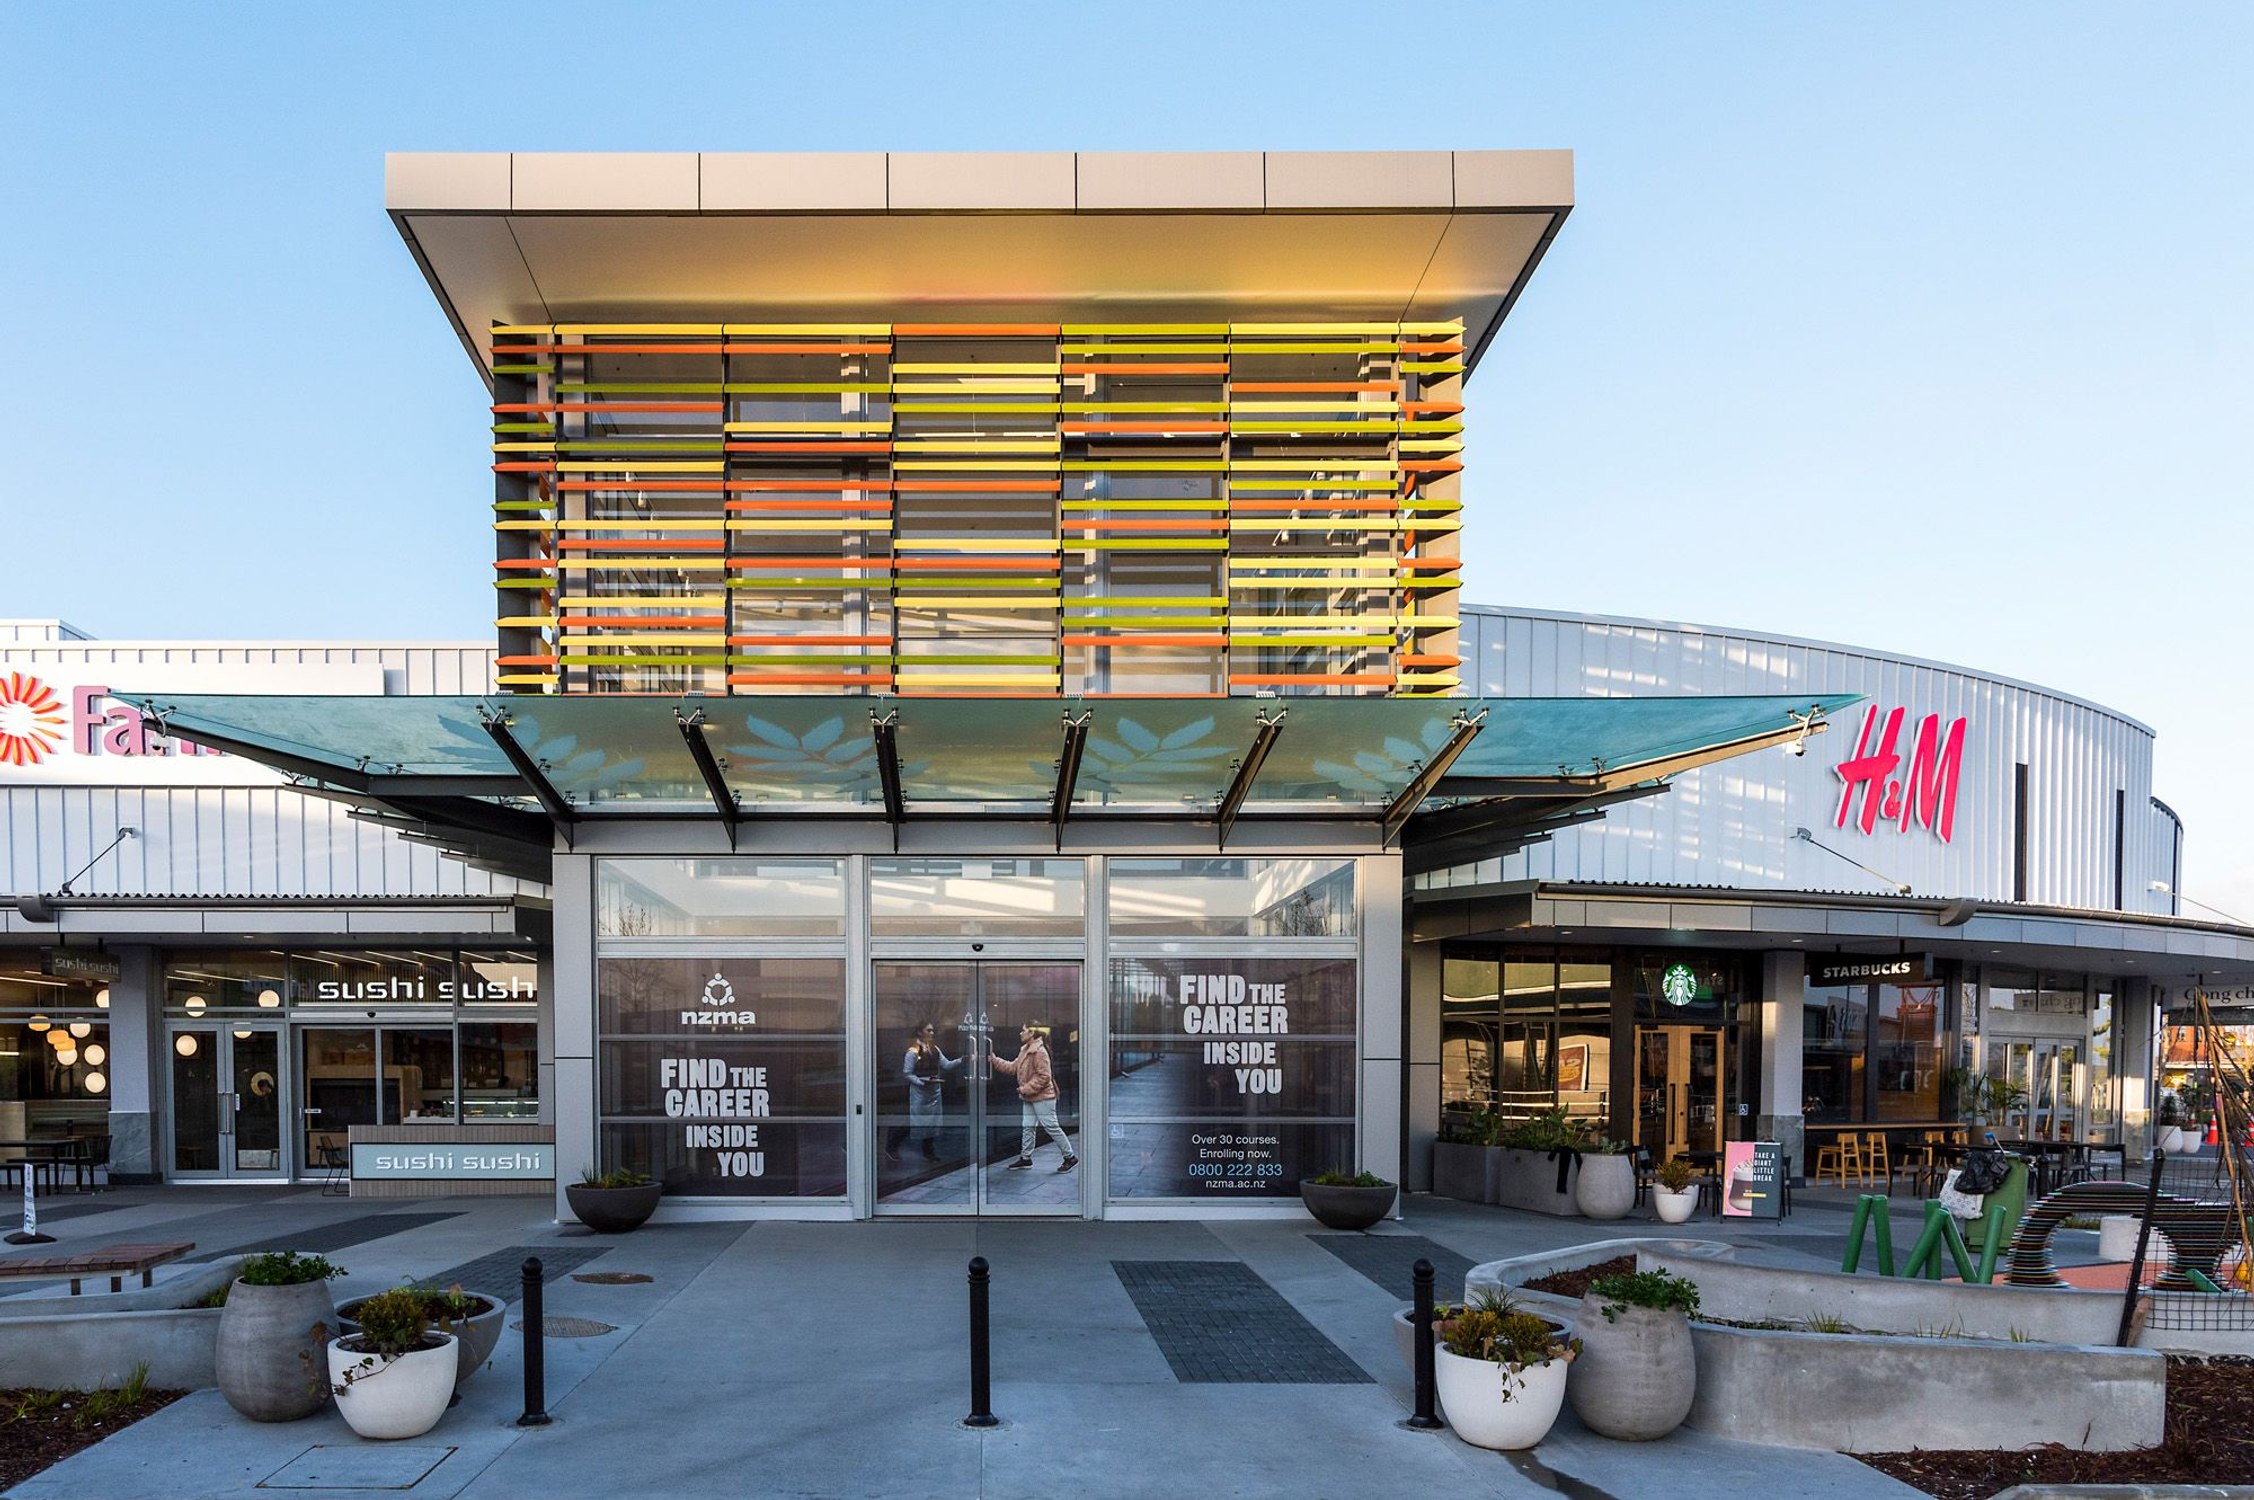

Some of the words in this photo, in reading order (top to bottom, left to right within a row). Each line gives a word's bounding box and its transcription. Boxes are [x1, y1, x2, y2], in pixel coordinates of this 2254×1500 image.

[1833, 704, 1967, 844] H&M
[55, 958, 87, 971] sushi
[89, 962, 119, 975] sushi
[1823, 962, 1911, 978] STARBUCKS
[318, 976, 424, 999] sushi
[438, 976, 534, 999] sush
[1180, 975, 1246, 1005] FIND
[1248, 984, 1286, 1005] THE
[681, 1010, 756, 1025] nzma
[1183, 1005, 1288, 1034] CAREER
[1203, 1042, 1276, 1065] INSIDE
[660, 1058, 727, 1088] FIND
[730, 1067, 767, 1088] THE
[1235, 1068, 1282, 1094] YOU
[665, 1089, 770, 1118] CAREER
[686, 1125, 758, 1148] INSIDE
[1191, 1134, 1217, 1145] Over
[1219, 1134, 1233, 1145] 30
[1235, 1135, 1280, 1145] courses.
[376, 1153, 454, 1170] sushi
[463, 1153, 541, 1170] sushi
[717, 1151, 765, 1177] YOU
[1200, 1149, 1244, 1160] Enrolling
[1247, 1150, 1272, 1158] now.
[1188, 1163, 1223, 1176] 0800
[1227, 1163, 1253, 1176] 222
[1257, 1163, 1283, 1176] 833
[1205, 1180, 1266, 1189] nzma.ac.nz
